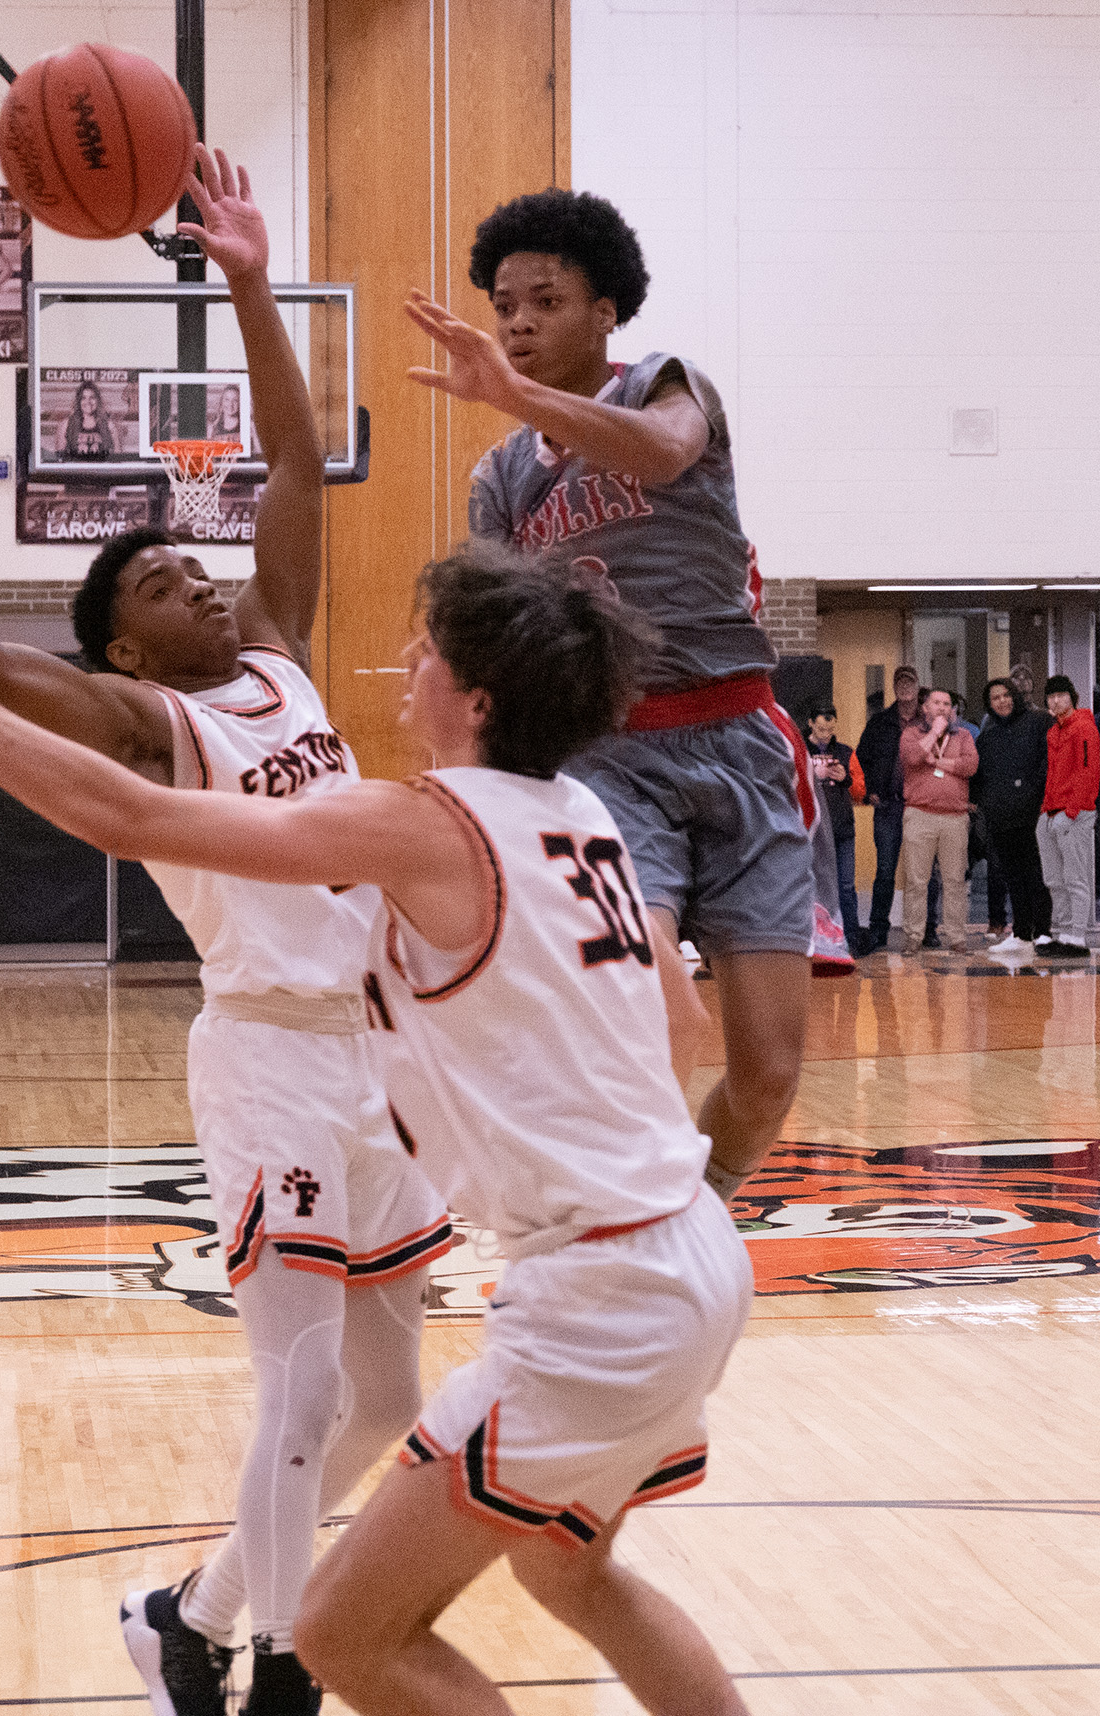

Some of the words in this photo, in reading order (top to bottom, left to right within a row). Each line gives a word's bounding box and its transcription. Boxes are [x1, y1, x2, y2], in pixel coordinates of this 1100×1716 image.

[45, 370, 82, 381] CLASS
[83, 370, 98, 381] OF
[99, 370, 128, 381] 2023
[47, 510, 126, 519] MADISON
[191, 521, 256, 540] CRAVE
[538, 831, 653, 969] 30
